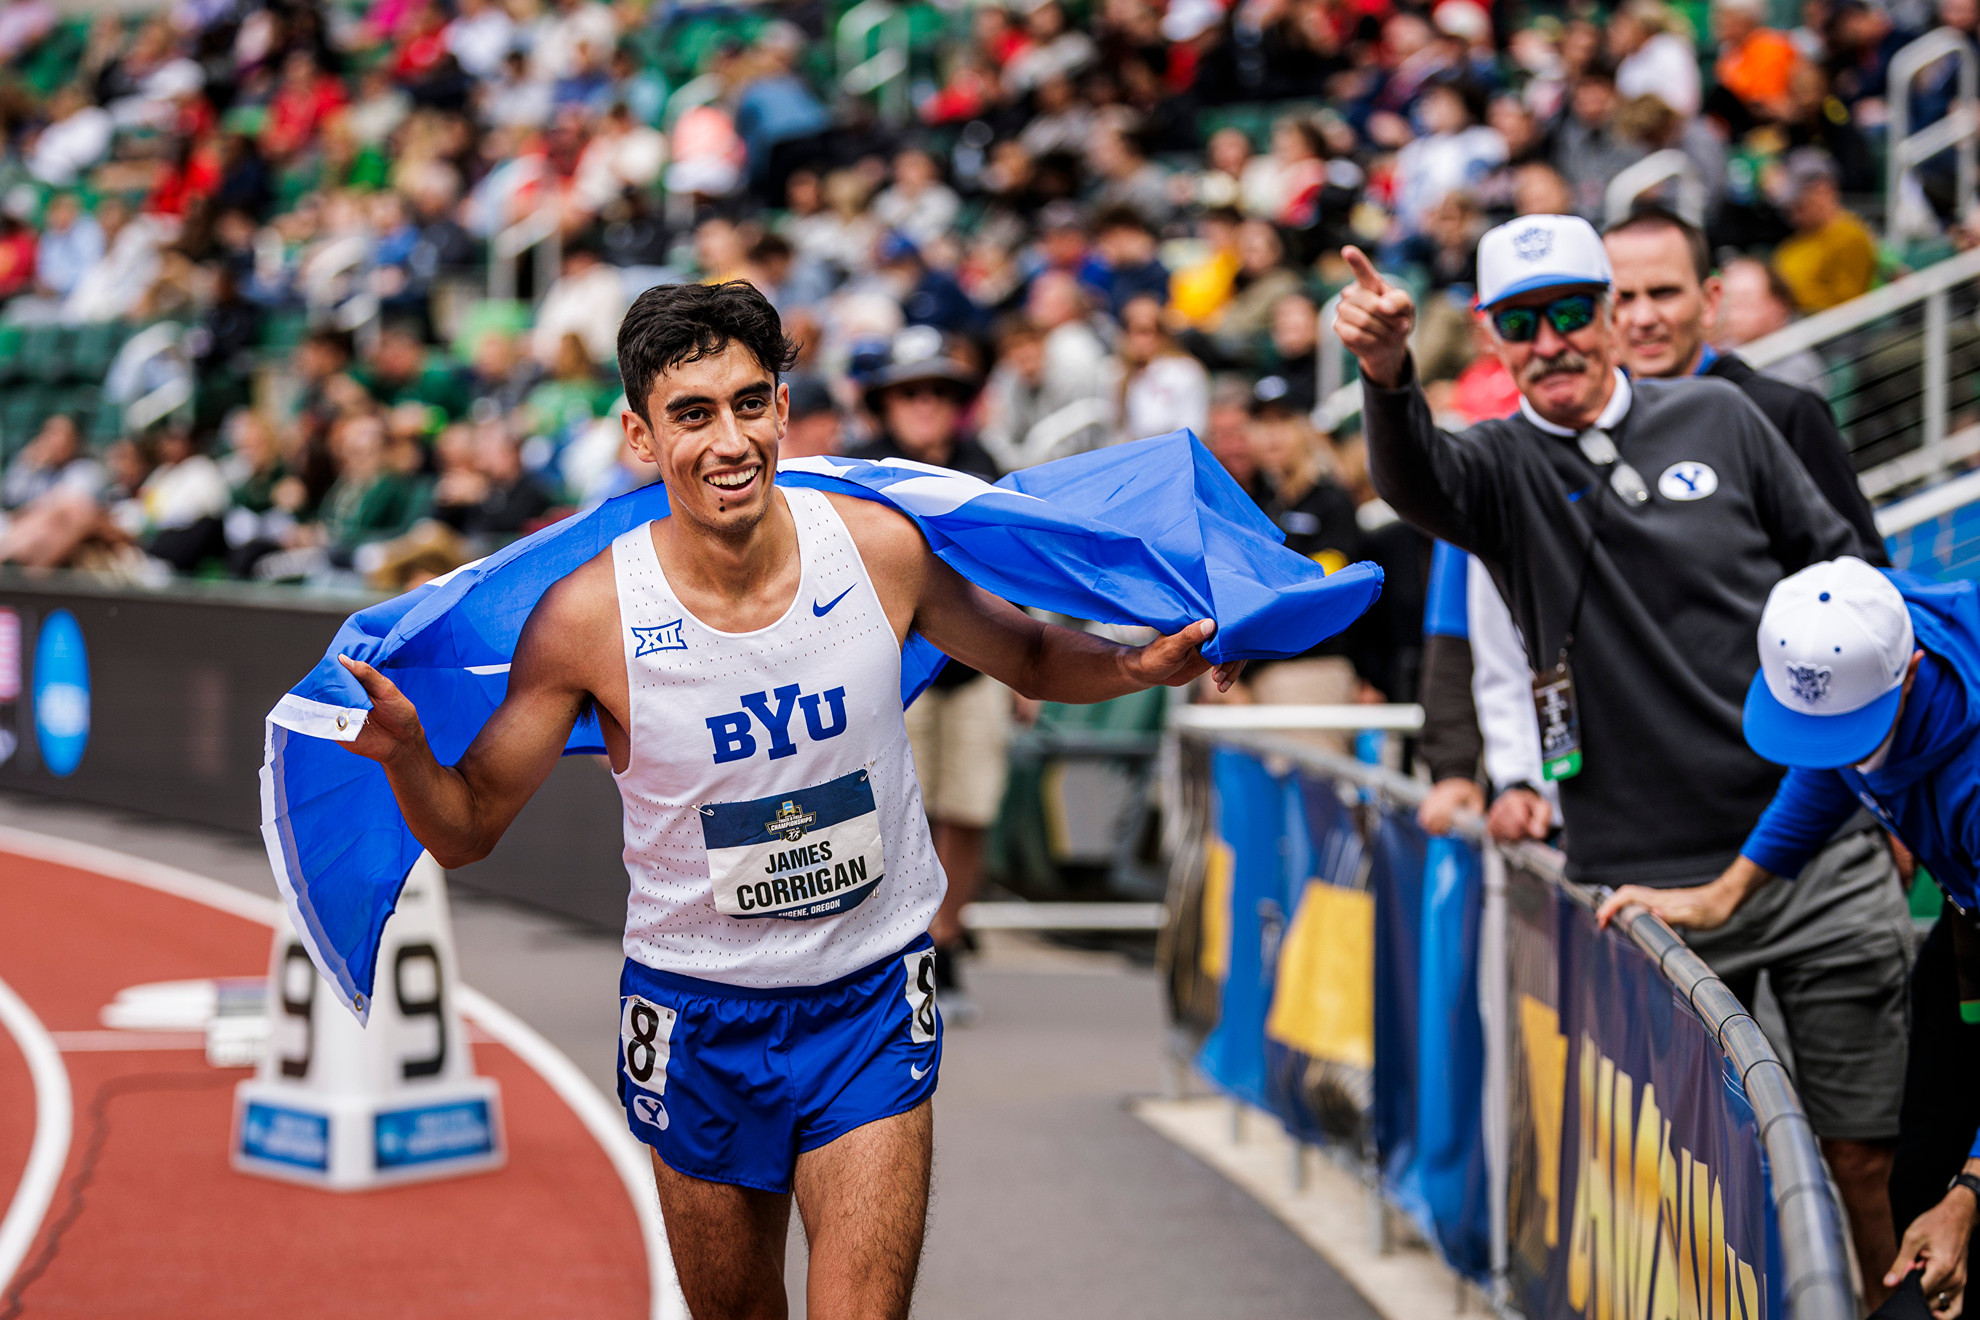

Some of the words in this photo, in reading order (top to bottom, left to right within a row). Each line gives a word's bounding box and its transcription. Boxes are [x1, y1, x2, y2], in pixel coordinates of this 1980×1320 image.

[1673, 467, 1702, 491] Y
[705, 682, 847, 765] BYU
[736, 855, 868, 911] CORRIGAN
[764, 840, 833, 874] JAMES
[810, 899, 841, 914] OREGON
[281, 942, 317, 1080] 9
[394, 942, 447, 1081] 9
[627, 1003, 659, 1083] 8
[637, 1098, 664, 1126] Y
